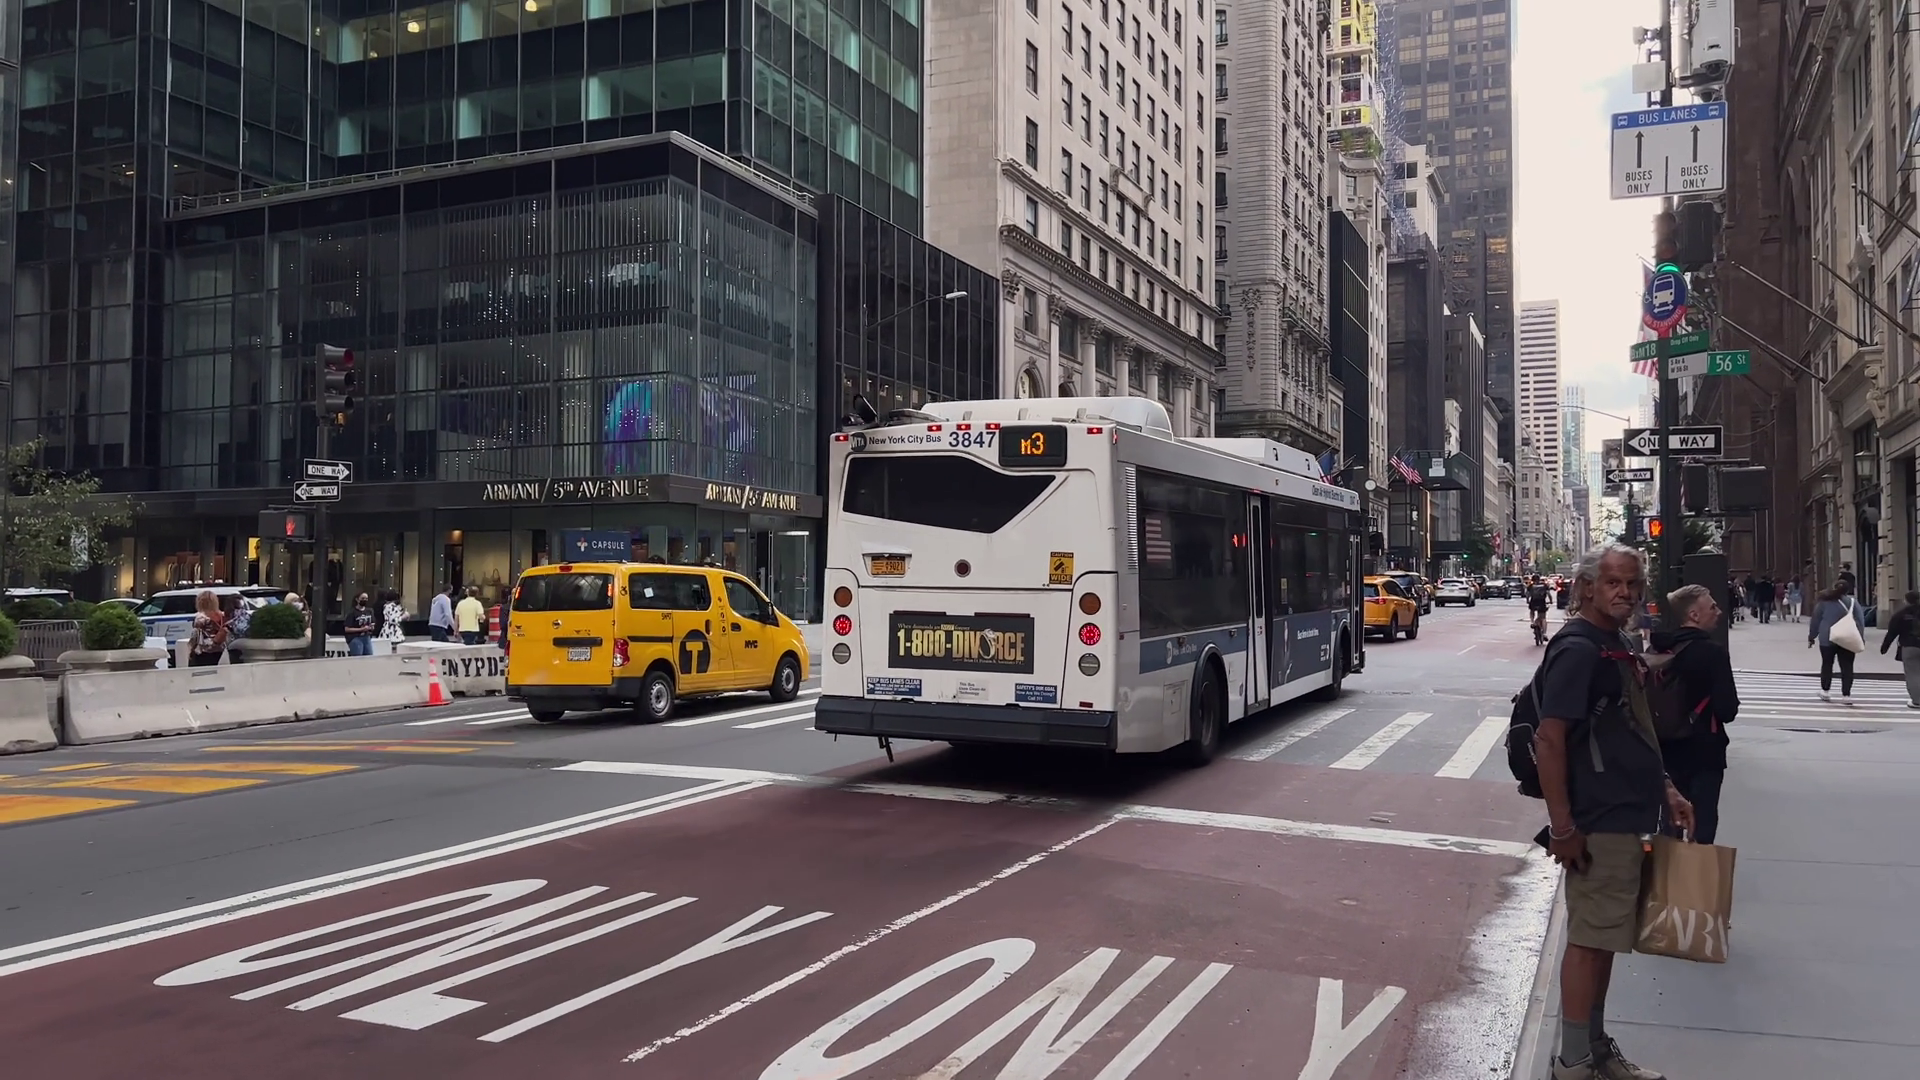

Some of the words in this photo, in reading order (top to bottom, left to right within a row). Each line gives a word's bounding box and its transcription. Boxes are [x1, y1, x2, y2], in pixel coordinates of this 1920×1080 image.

[1638, 113, 1659, 124] BUS
[1663, 108, 1698, 121] LANES
[1625, 170, 1653, 182] BUSES
[1680, 165, 1709, 176] BUSES
[1627, 182, 1651, 194] ONLY
[1682, 178, 1706, 189] ONLY
[1652, 308, 1682, 328] STANDING
[1716, 355, 1732, 372] 56
[1737, 354, 1746, 365] St
[868, 436, 886, 445] New
[886, 435, 905, 444] York
[907, 435, 924, 445] City
[926, 434, 942, 443] Bus
[949, 431, 996, 448] 3847
[1679, 436, 1709, 448] WAY
[312, 466, 326, 474] ONE
[331, 468, 346, 476] WAY
[300, 487, 314, 496] ONE
[321, 487, 336, 495] WAY
[577, 478, 648, 498] AVENUE
[592, 540, 624, 550] CAPSULE
[744, 640, 758, 649] NYC
[448, 656, 499, 678] NYPD
[153, 878, 835, 1043] ONLY
